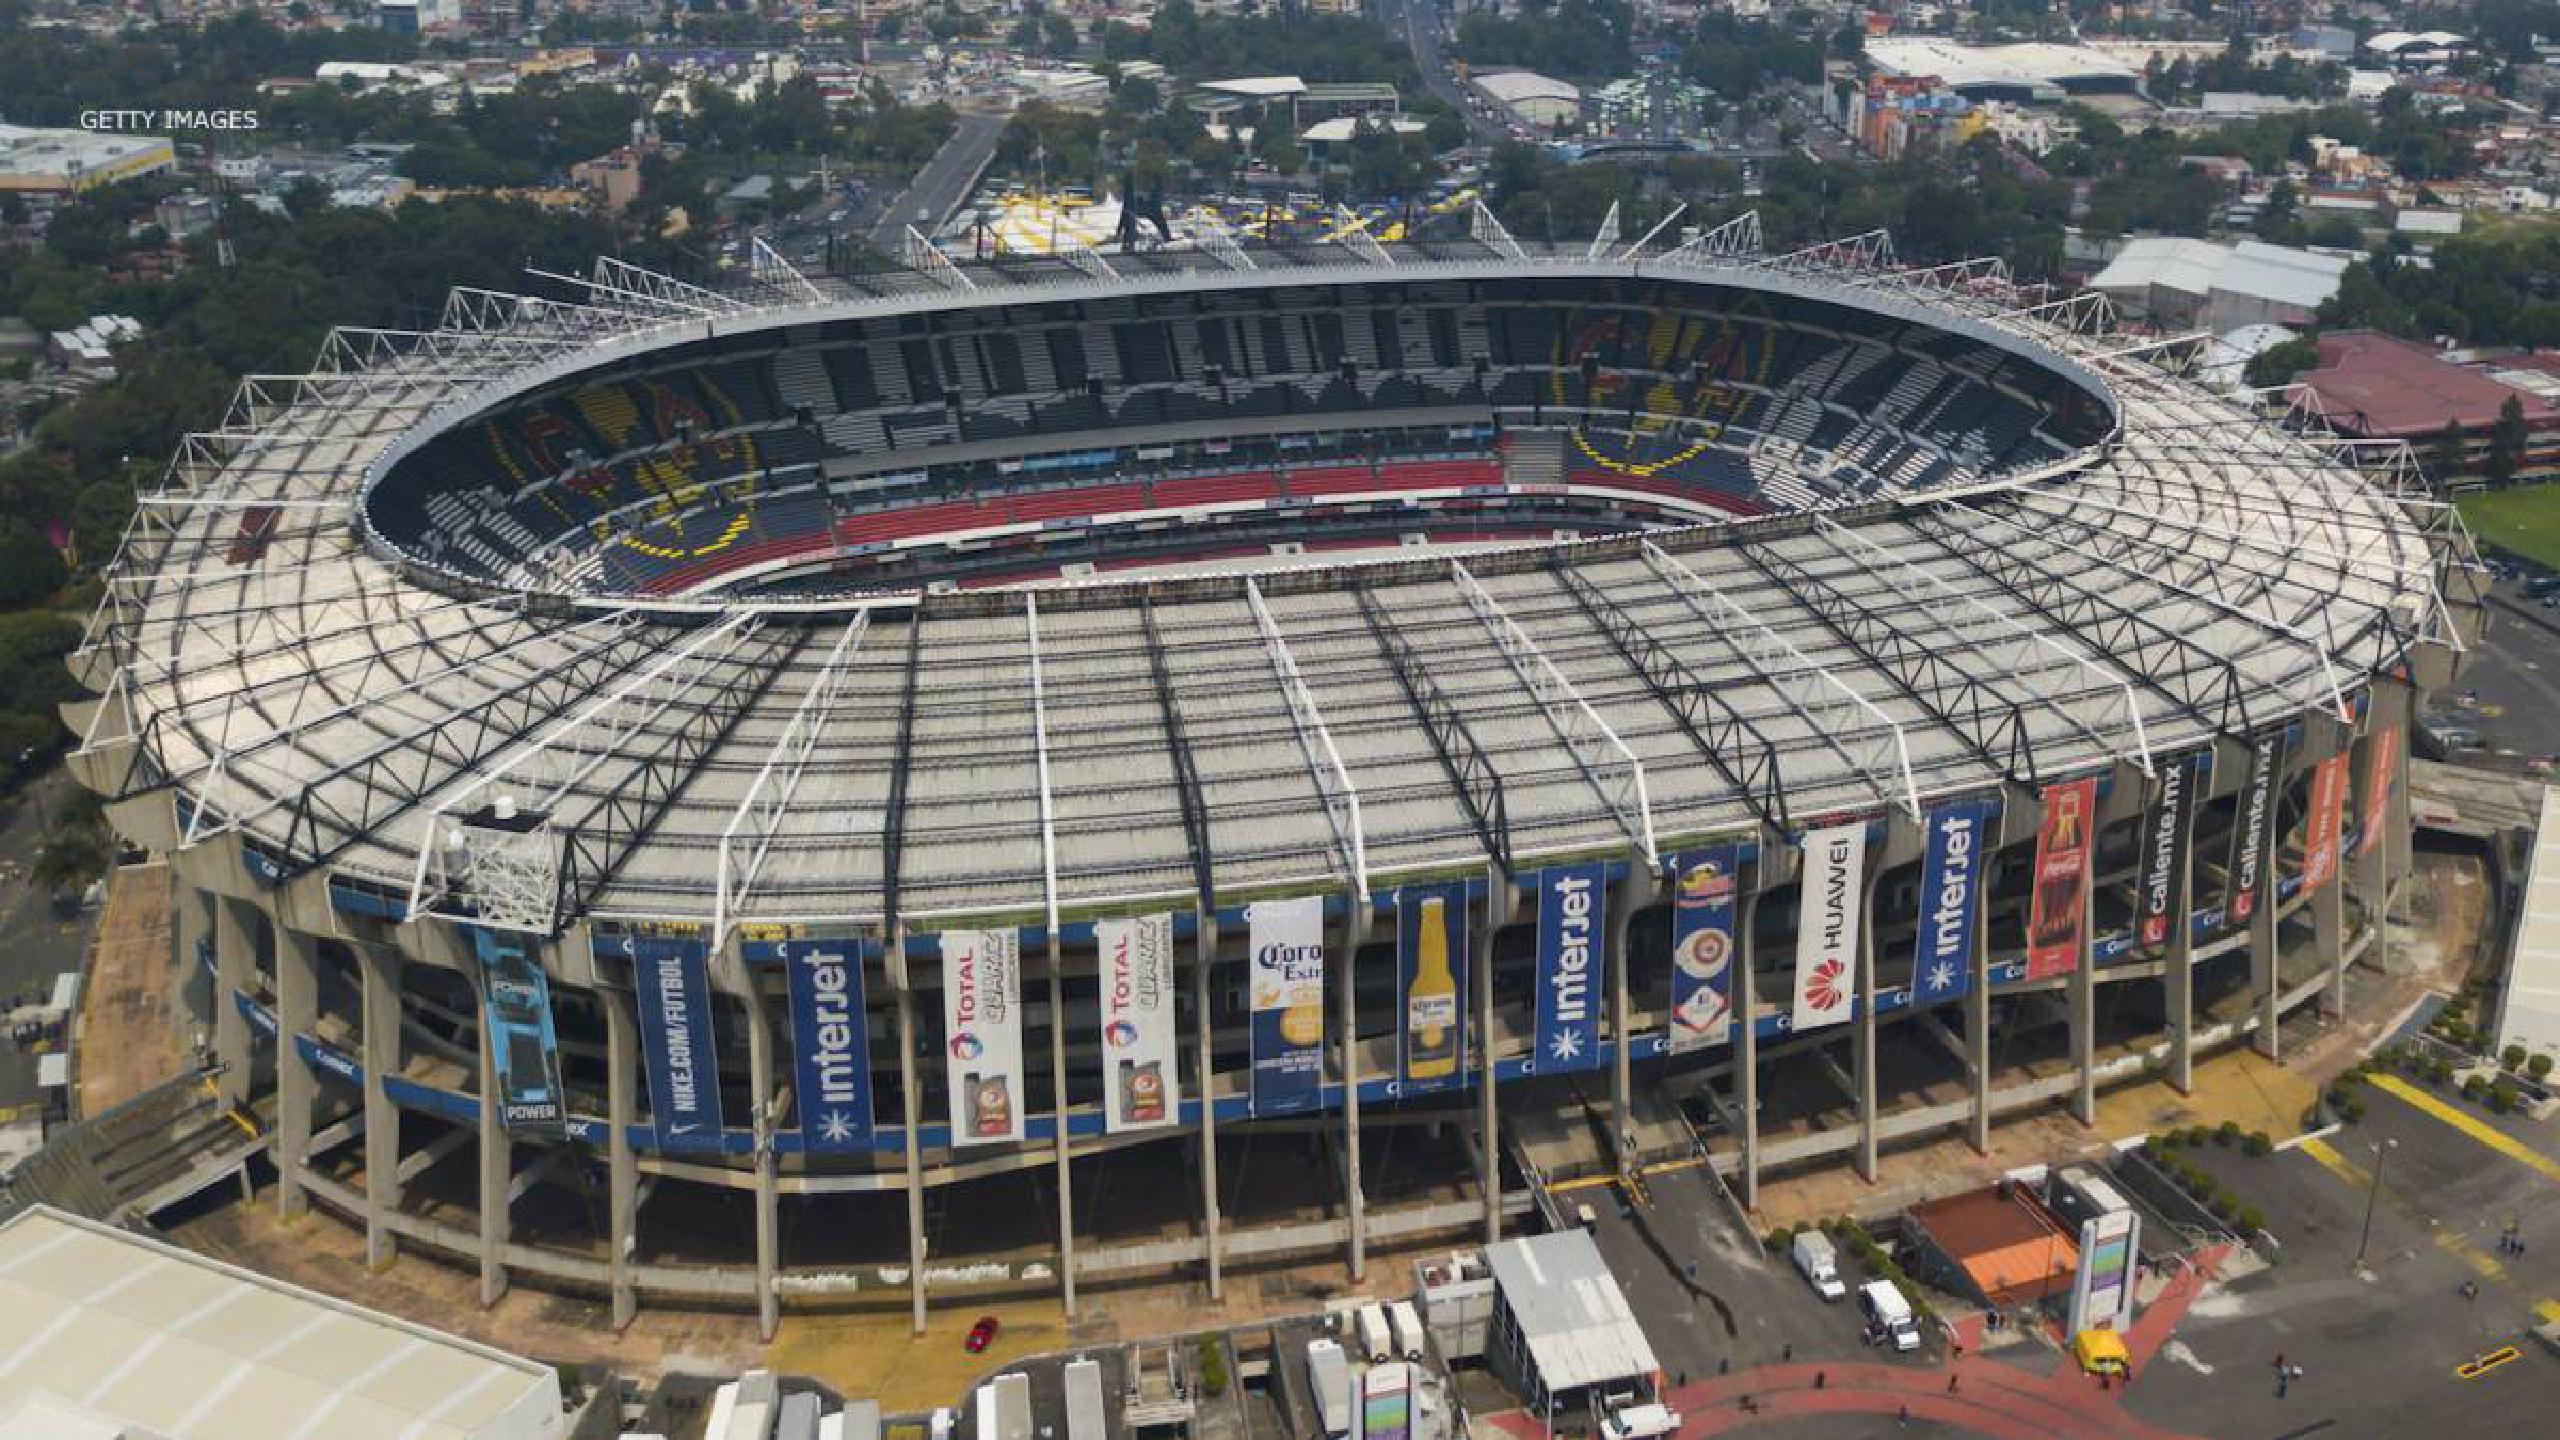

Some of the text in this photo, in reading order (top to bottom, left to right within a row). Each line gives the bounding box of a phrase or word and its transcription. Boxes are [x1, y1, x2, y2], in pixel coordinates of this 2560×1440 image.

[1823, 837, 1849, 950] HUAWEI
[1932, 816, 1972, 957] interjet
[2149, 765, 2183, 915] caliente.mx
[957, 947, 975, 1026] TOTAL
[1111, 933, 1129, 1014] TOTAL
[1551, 875, 1592, 1022] interjet
[658, 955, 697, 1112] NIKE.COM/FUTBOL
[802, 948, 855, 1102] interjet
[507, 1105, 556, 1120] POWER
